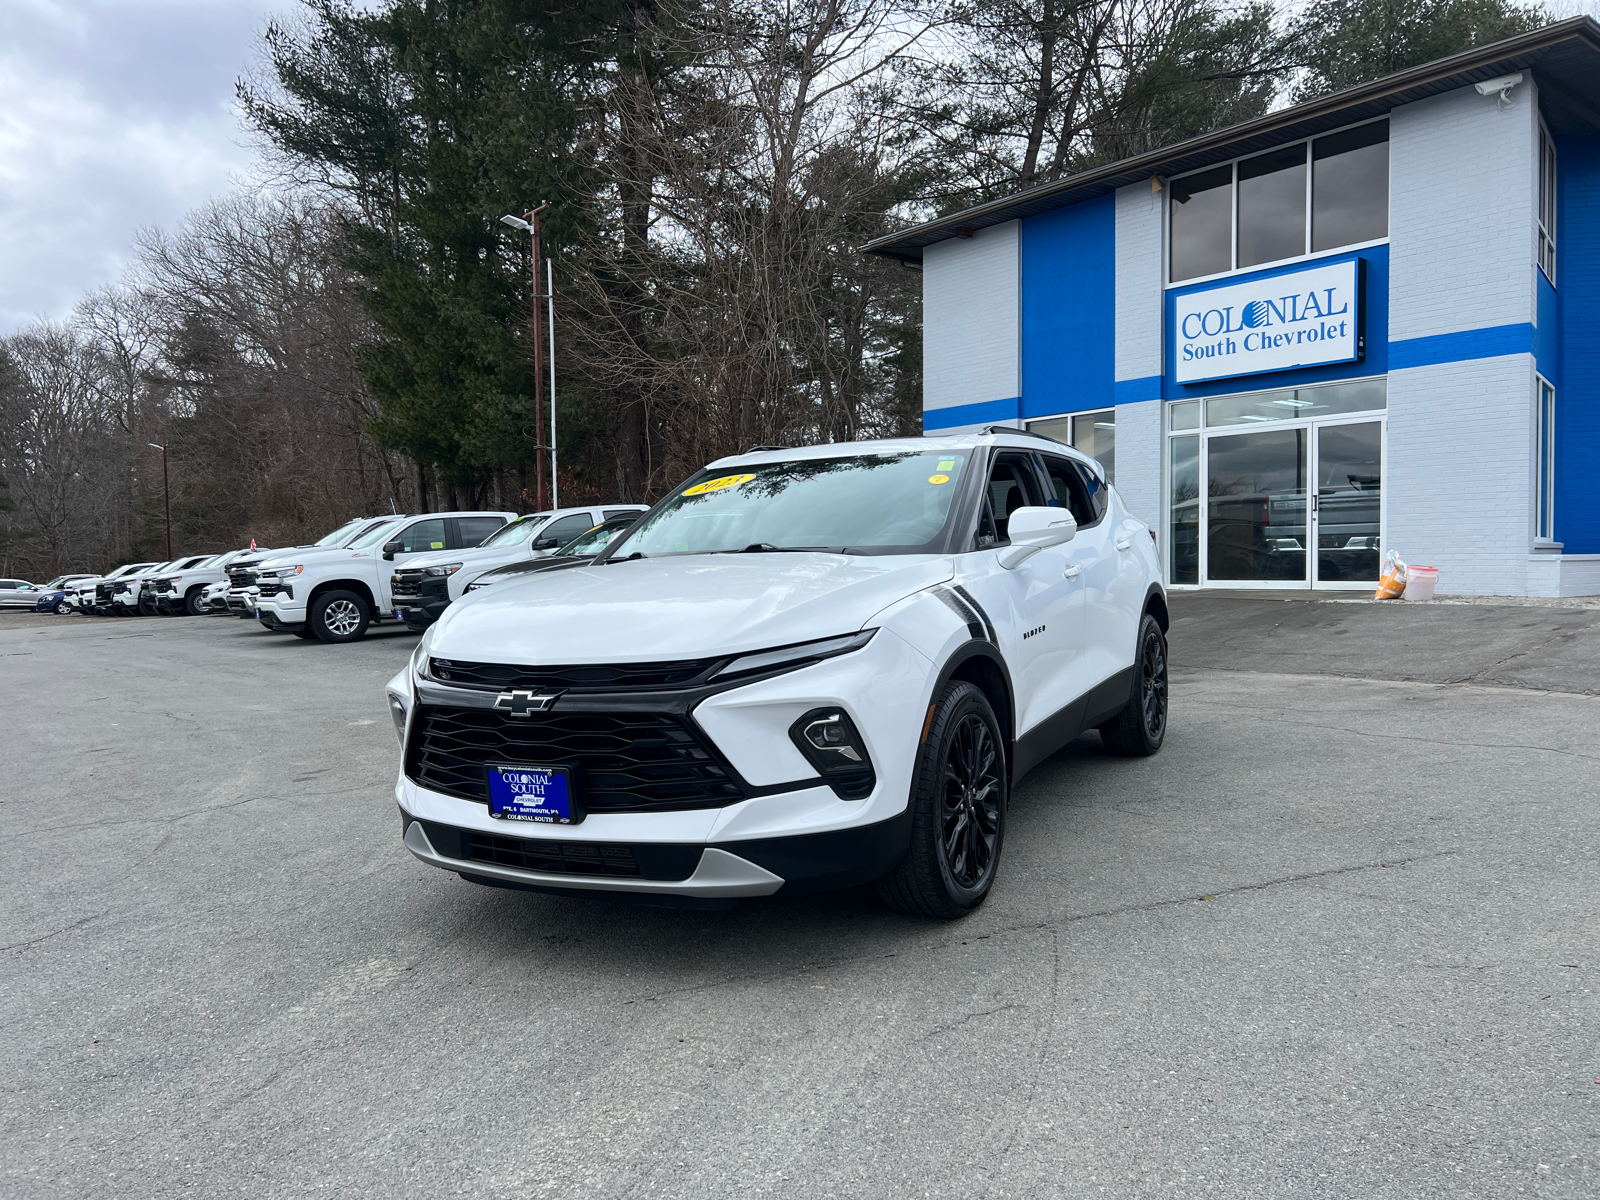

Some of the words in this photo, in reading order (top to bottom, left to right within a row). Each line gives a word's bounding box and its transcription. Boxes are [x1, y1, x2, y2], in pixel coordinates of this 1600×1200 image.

[1181, 287, 1348, 340] COLONIAL
[1182, 337, 1237, 362] South
[1243, 319, 1348, 352] Chevrolet
[503, 773, 552, 785] COLONIAL
[511, 784, 545, 794] SOUTH
